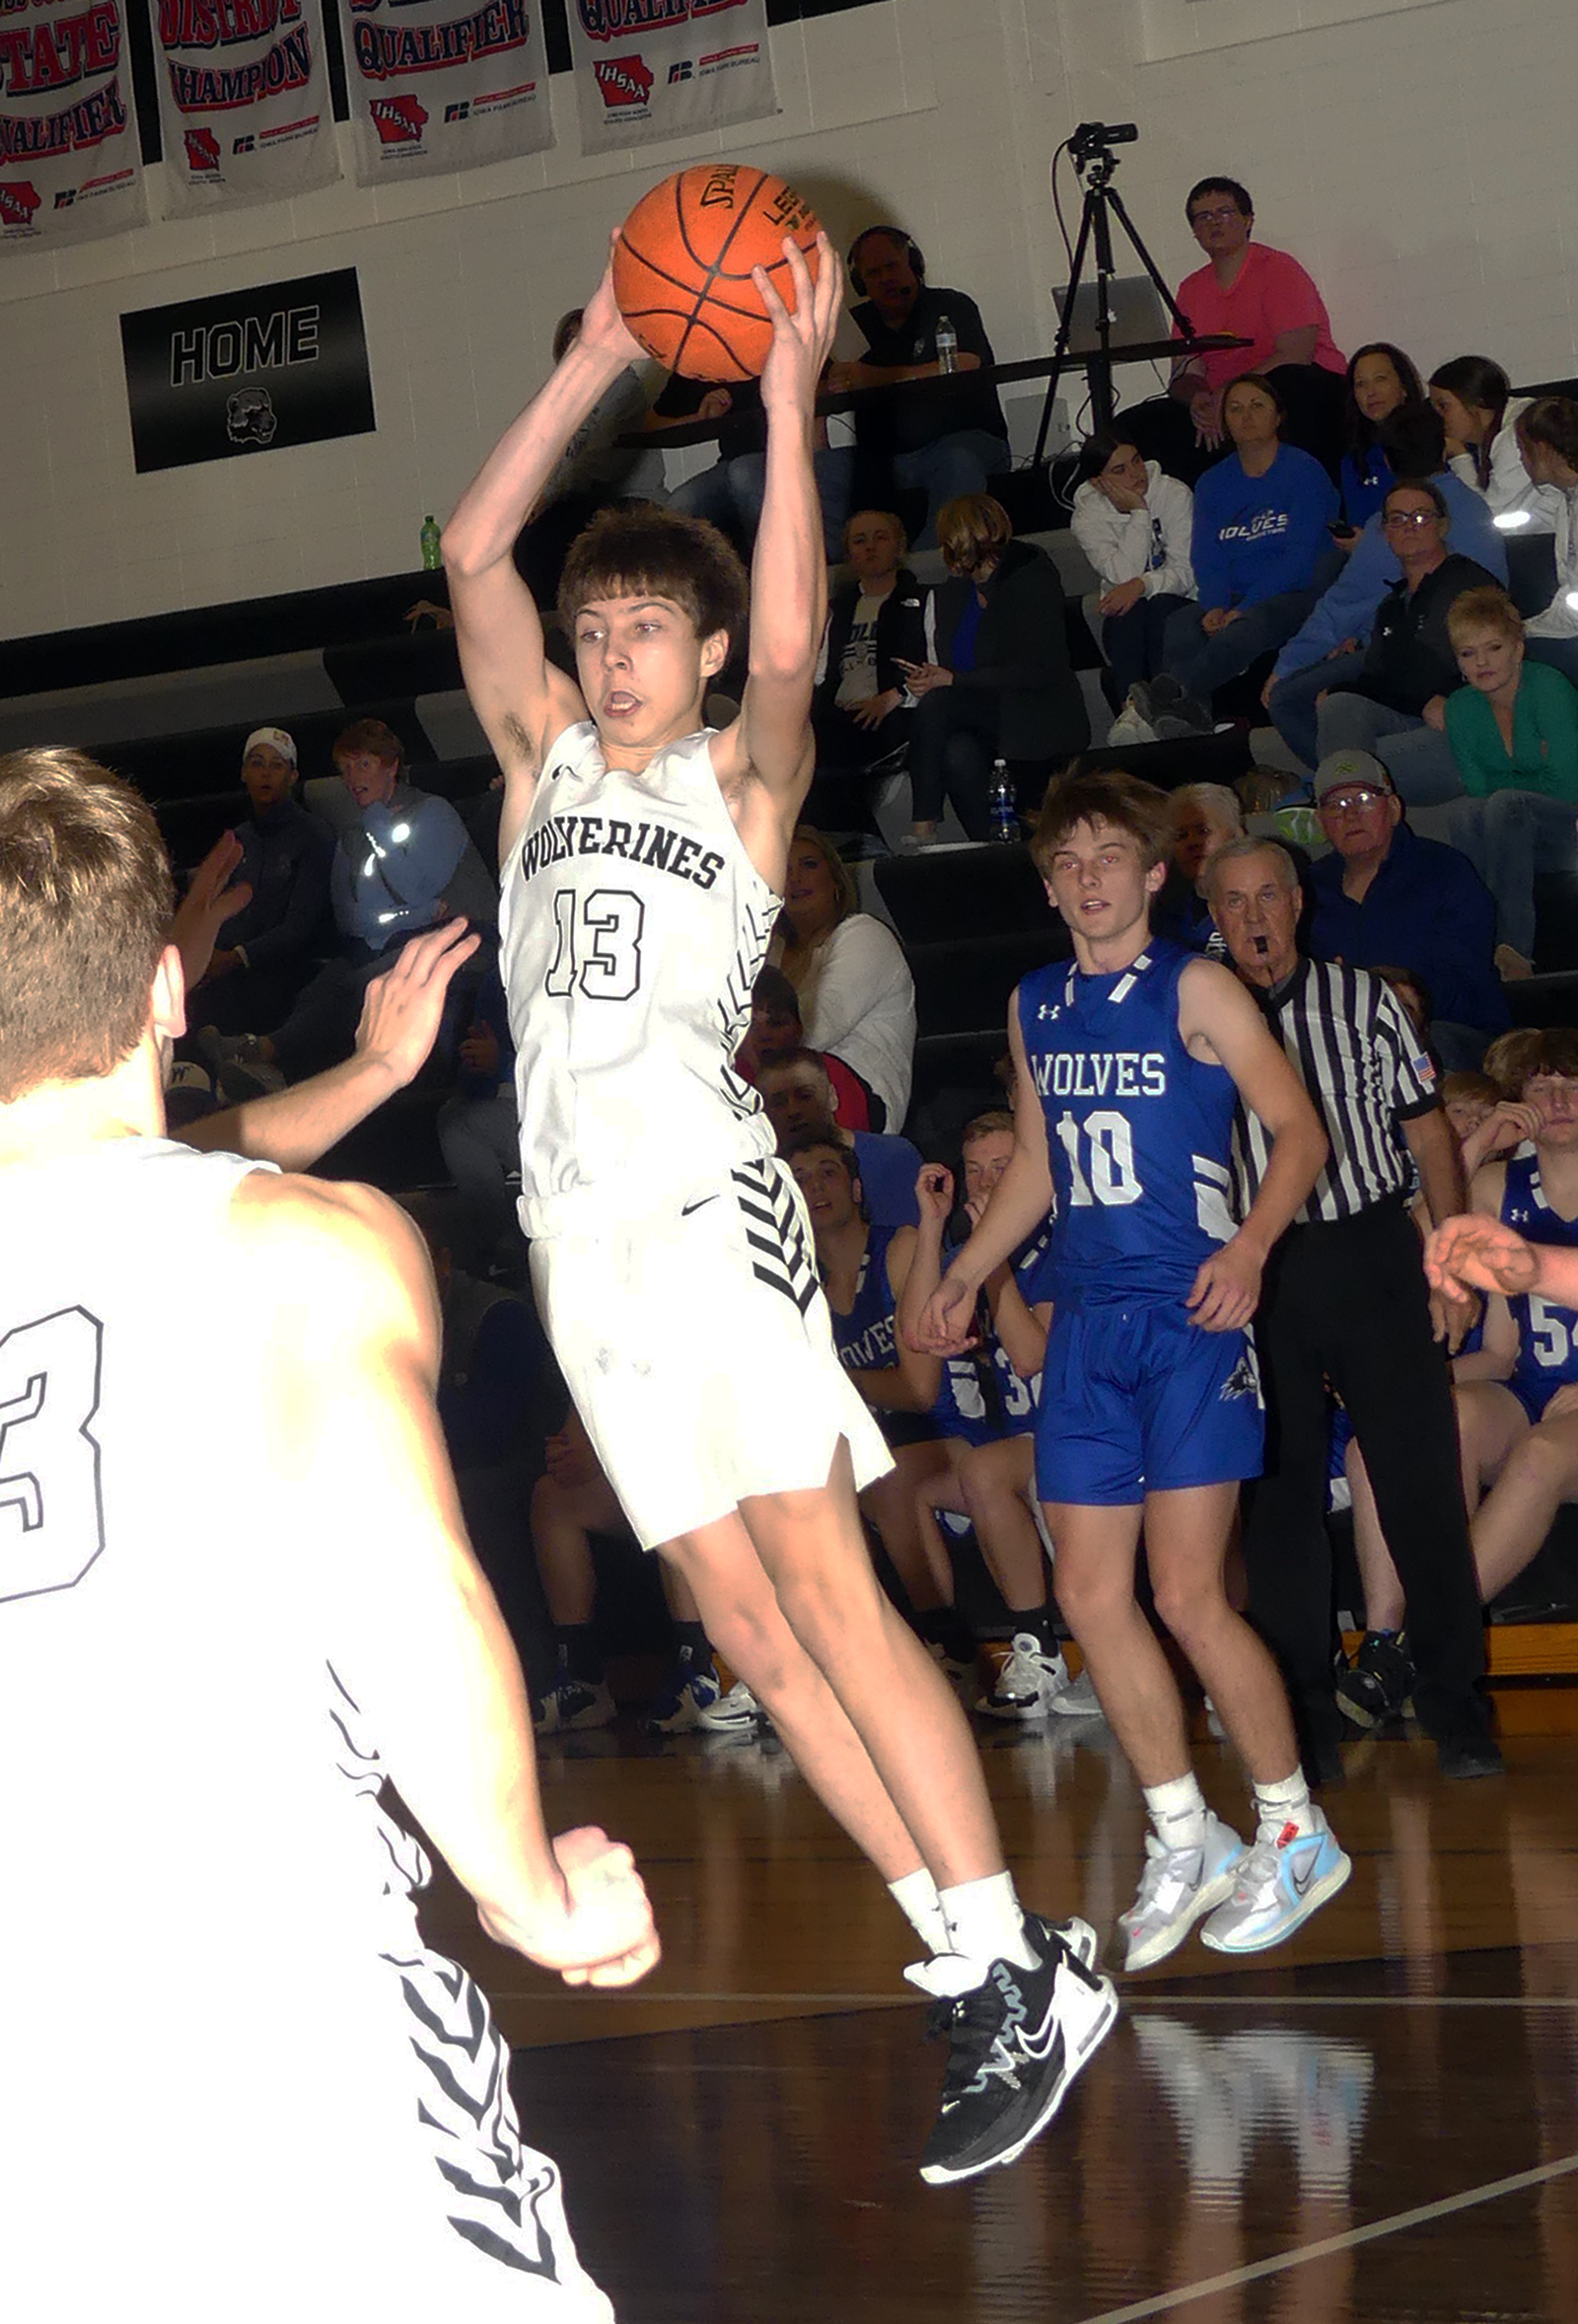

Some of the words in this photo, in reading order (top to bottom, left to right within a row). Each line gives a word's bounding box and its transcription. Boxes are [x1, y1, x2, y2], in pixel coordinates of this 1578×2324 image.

[0, 2, 120, 97] TATE
[168, 22, 312, 112] HAMPION
[353, 0, 530, 81] QUALIFIER
[599, 63, 646, 99] IHSAA
[0, 76, 126, 166] UALIFIER
[376, 102, 418, 136] IHSAA
[171, 305, 320, 387] HOME
[522, 816, 726, 890] WOLVERINES
[544, 889, 646, 1002] 13
[1031, 1053, 1166, 1097] WOLVES
[1056, 1111, 1144, 1205] 10
[1529, 1294, 1578, 1367] 5
